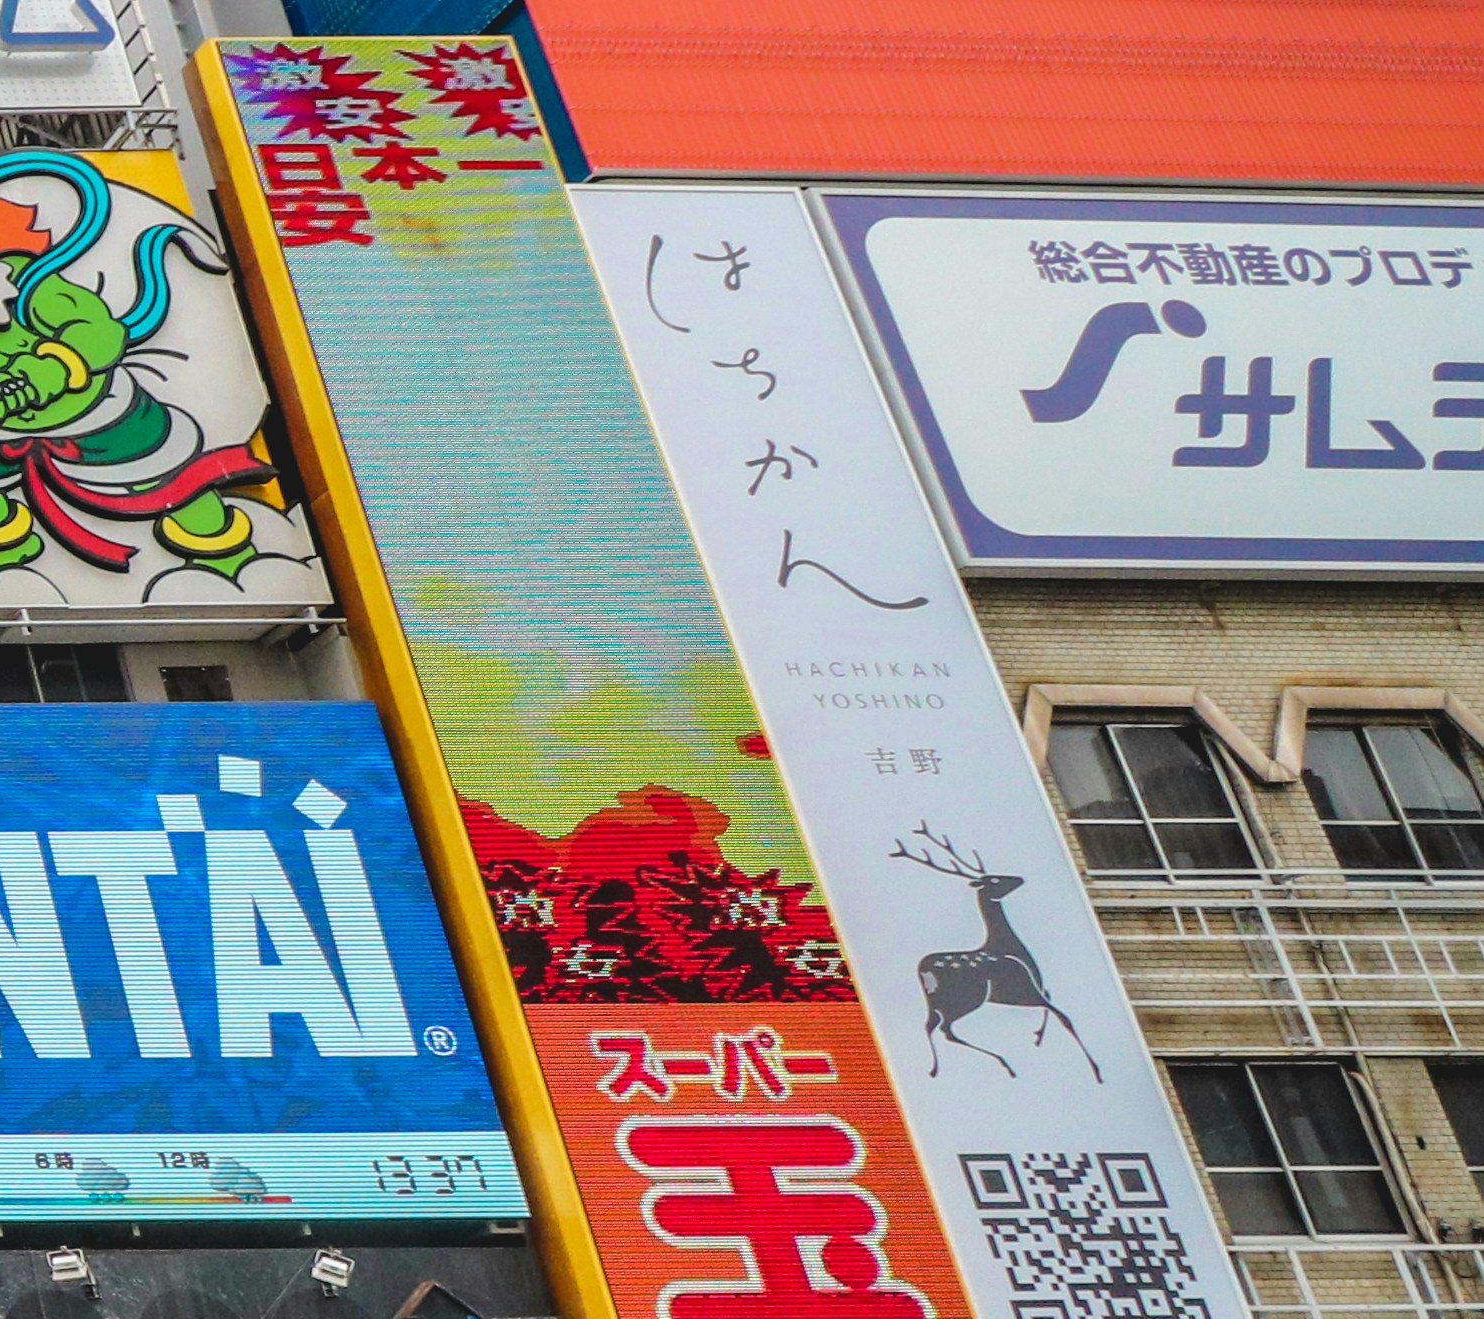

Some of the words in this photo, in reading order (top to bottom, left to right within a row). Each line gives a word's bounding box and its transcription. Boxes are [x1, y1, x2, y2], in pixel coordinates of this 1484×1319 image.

[257, 141, 544, 190] 日本一
[784, 658, 958, 682] HACHIKAN
[810, 690, 950, 713] YOSHINO
[863, 743, 949, 779] 吉野
[590, 1023, 840, 1101] スーパー
[32, 1151, 74, 1173] 6時
[156, 1151, 212, 1173] 12時
